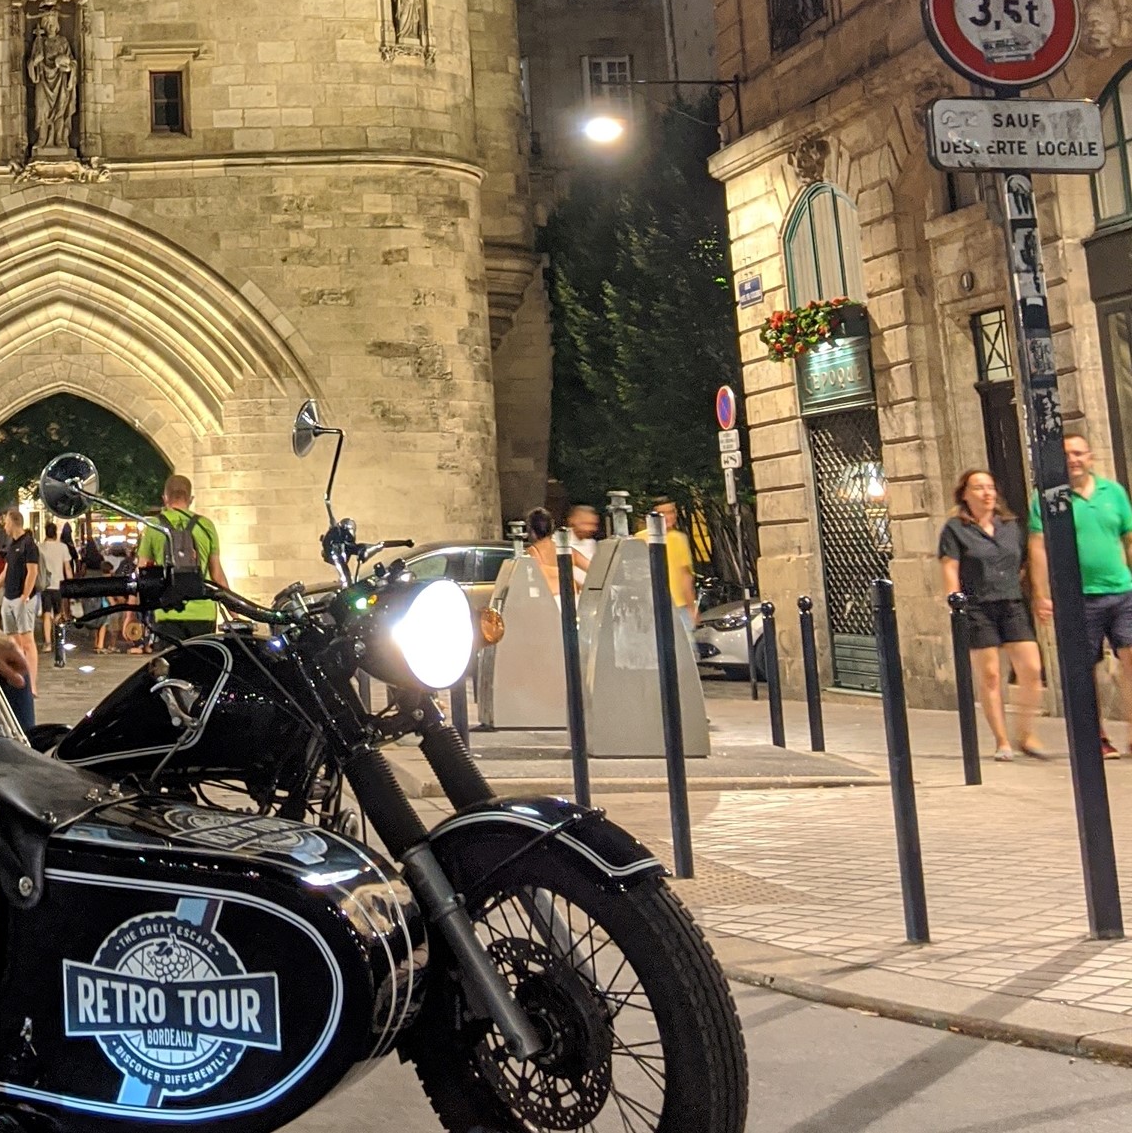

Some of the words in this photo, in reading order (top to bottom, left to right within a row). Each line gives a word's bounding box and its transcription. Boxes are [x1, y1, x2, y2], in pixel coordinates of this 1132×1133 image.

[993, 113, 1042, 128] SAUF
[940, 140, 1028, 156] DESERTE
[1036, 141, 1099, 157] LOCALE
[118, 933, 138, 947] THE
[140, 923, 172, 937] GREAT
[176, 926, 214, 953] ESCAPE
[78, 976, 166, 1023] RETRO
[177, 988, 262, 1034] TOUR
[146, 1028, 194, 1048] BORDEAUX
[115, 1047, 161, 1081] DISCOVER
[164, 1051, 229, 1084] DIFFERENTLY
